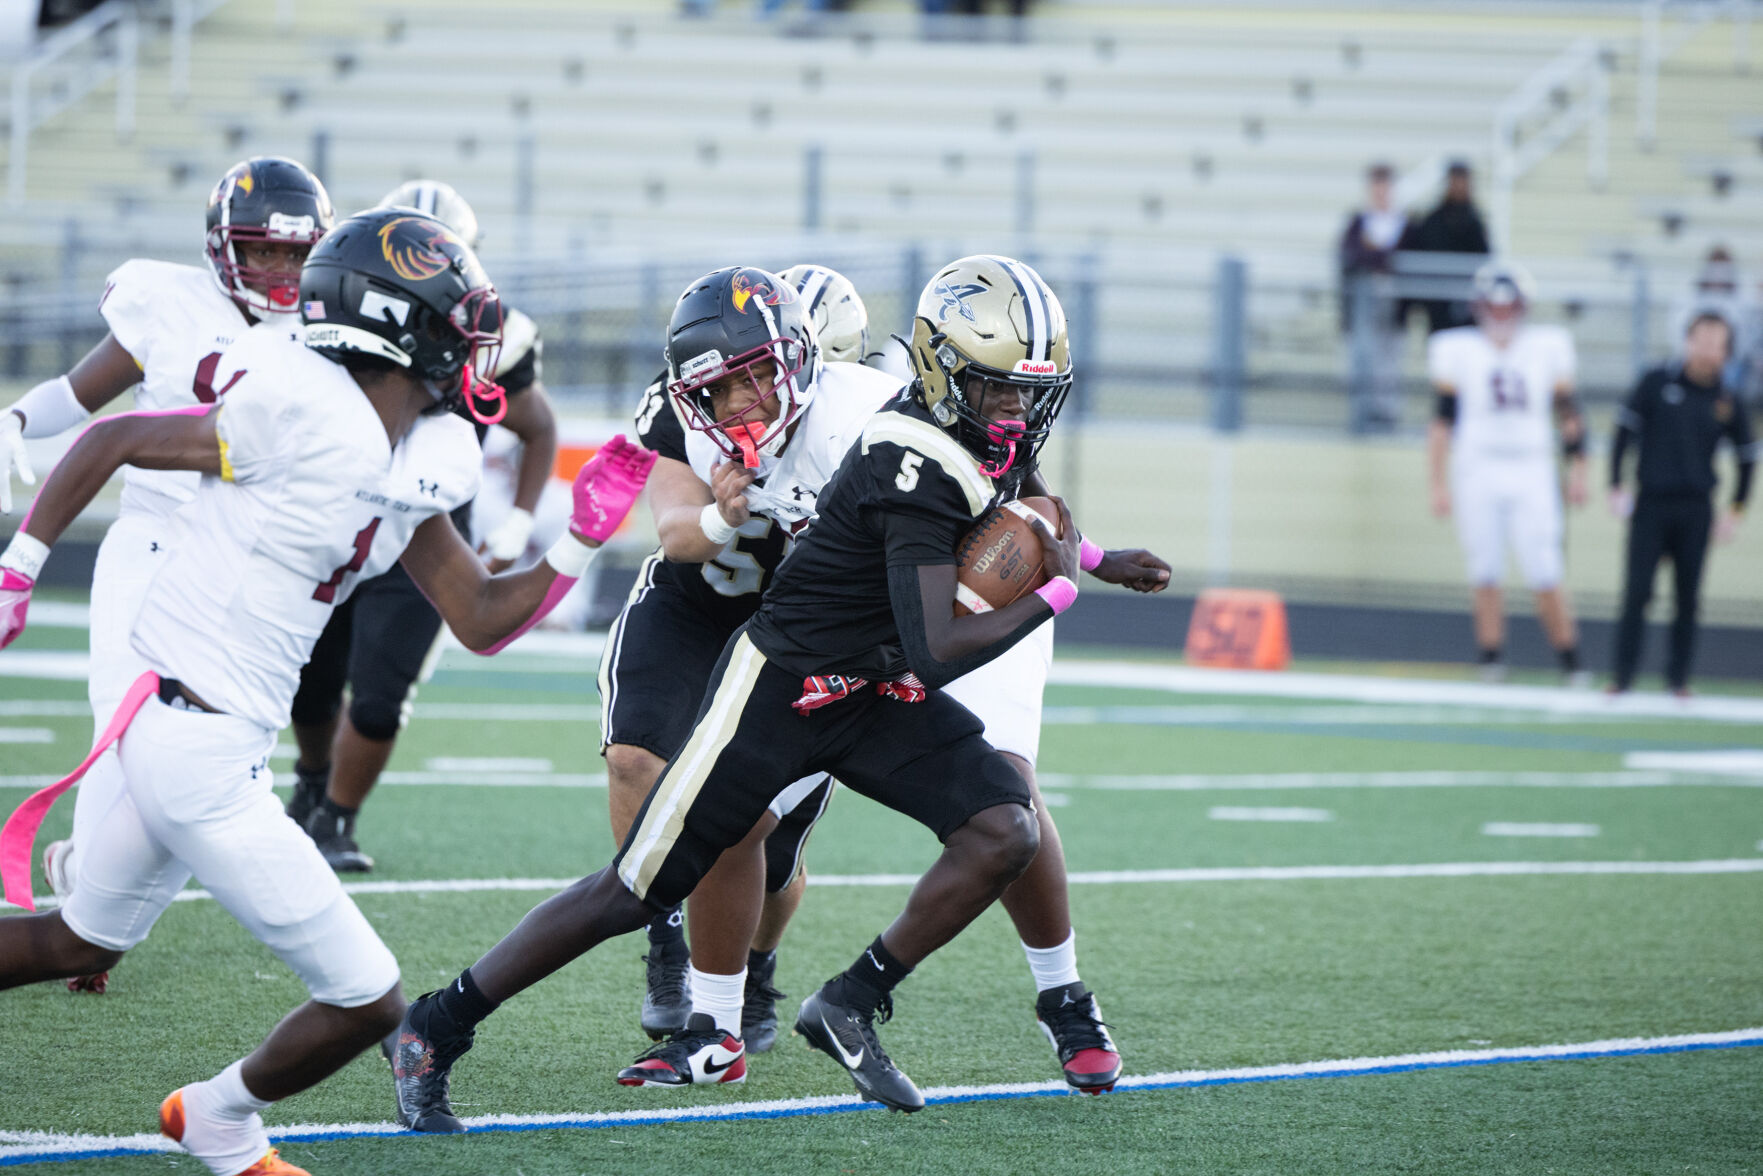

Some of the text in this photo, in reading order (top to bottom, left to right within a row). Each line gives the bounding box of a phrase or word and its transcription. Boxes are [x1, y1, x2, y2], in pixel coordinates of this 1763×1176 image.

[1021, 363, 1054, 373] Riddell
[895, 450, 924, 493] 5
[312, 516, 383, 604] 1
[972, 531, 1016, 573] Wilson
[1000, 546, 1023, 580] GST
